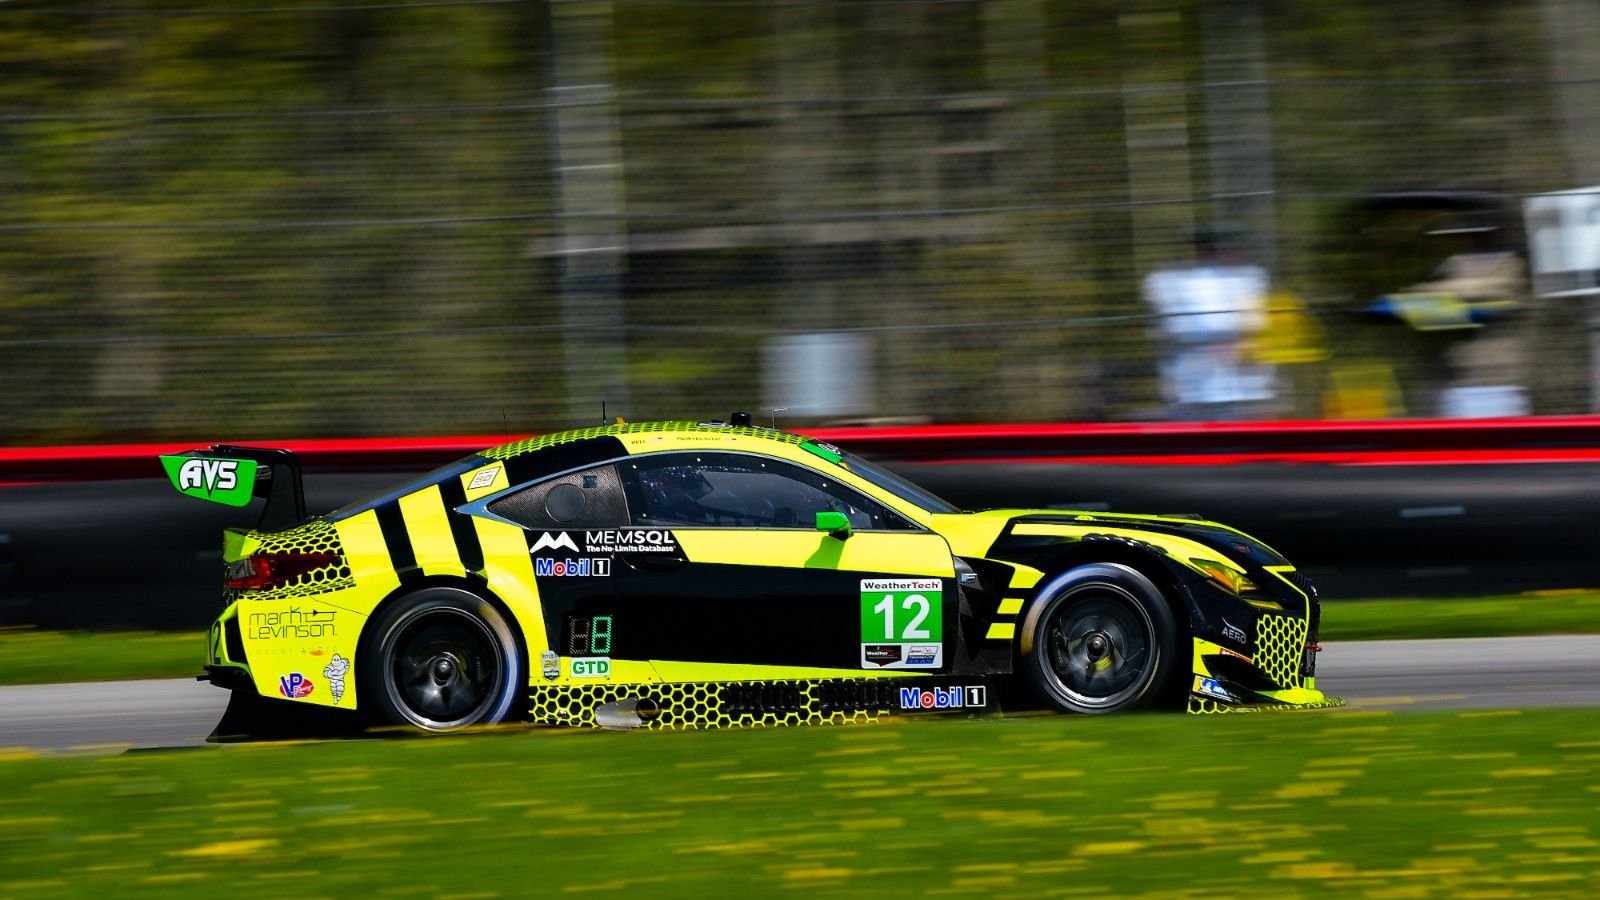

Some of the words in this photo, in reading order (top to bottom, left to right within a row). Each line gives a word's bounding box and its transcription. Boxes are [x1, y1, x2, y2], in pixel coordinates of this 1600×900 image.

[179, 459, 238, 493] AVS
[586, 530, 675, 545] MEMSQL
[536, 558, 590, 576] Mobil
[864, 581, 939, 590] WeatherTech
[249, 606, 302, 626] mark
[874, 594, 931, 640] 12
[1221, 627, 1247, 645] AERO
[572, 661, 609, 675] GTD
[900, 685, 963, 709] Mobil
